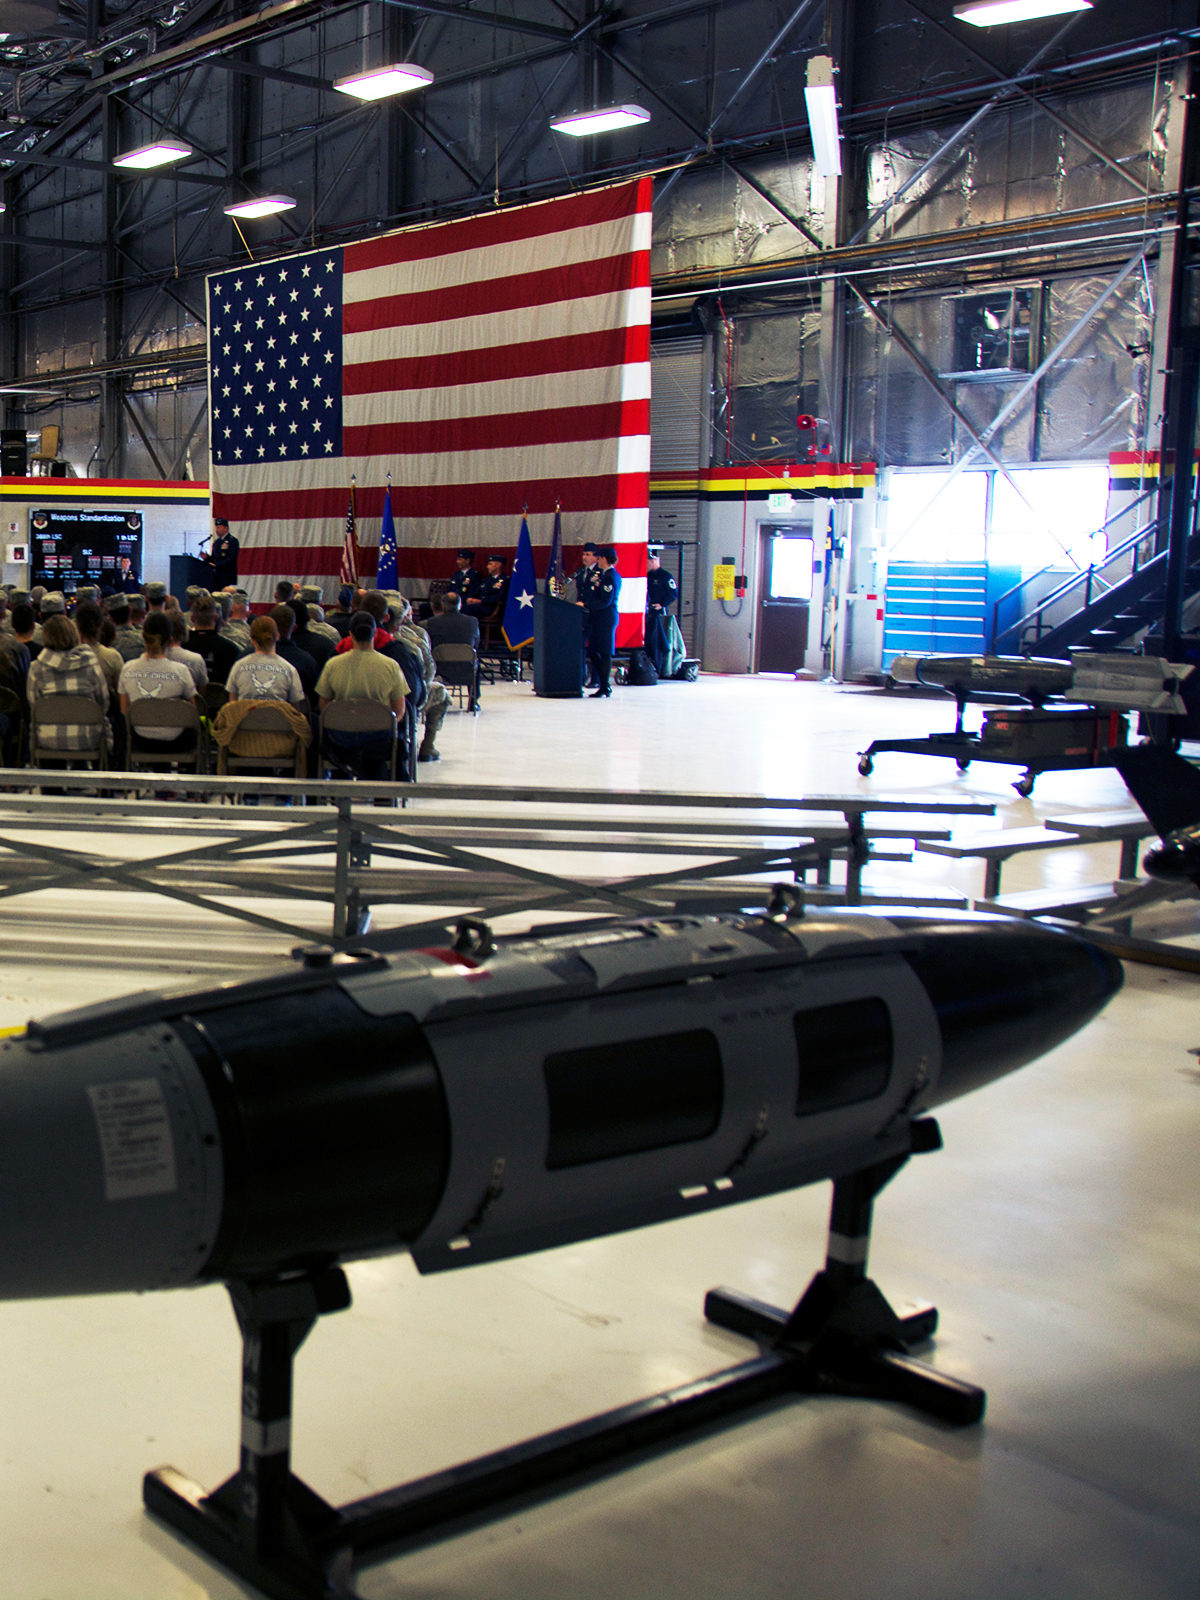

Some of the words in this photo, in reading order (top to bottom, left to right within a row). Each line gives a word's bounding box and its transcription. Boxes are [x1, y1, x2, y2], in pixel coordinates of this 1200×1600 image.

[773, 495, 786, 507] EXIT
[50, 514, 78, 522] Weapons
[80, 514, 125, 522] Standardization
[143, 671, 180, 680] FORCE
[258, 664, 290, 677] FORCE
